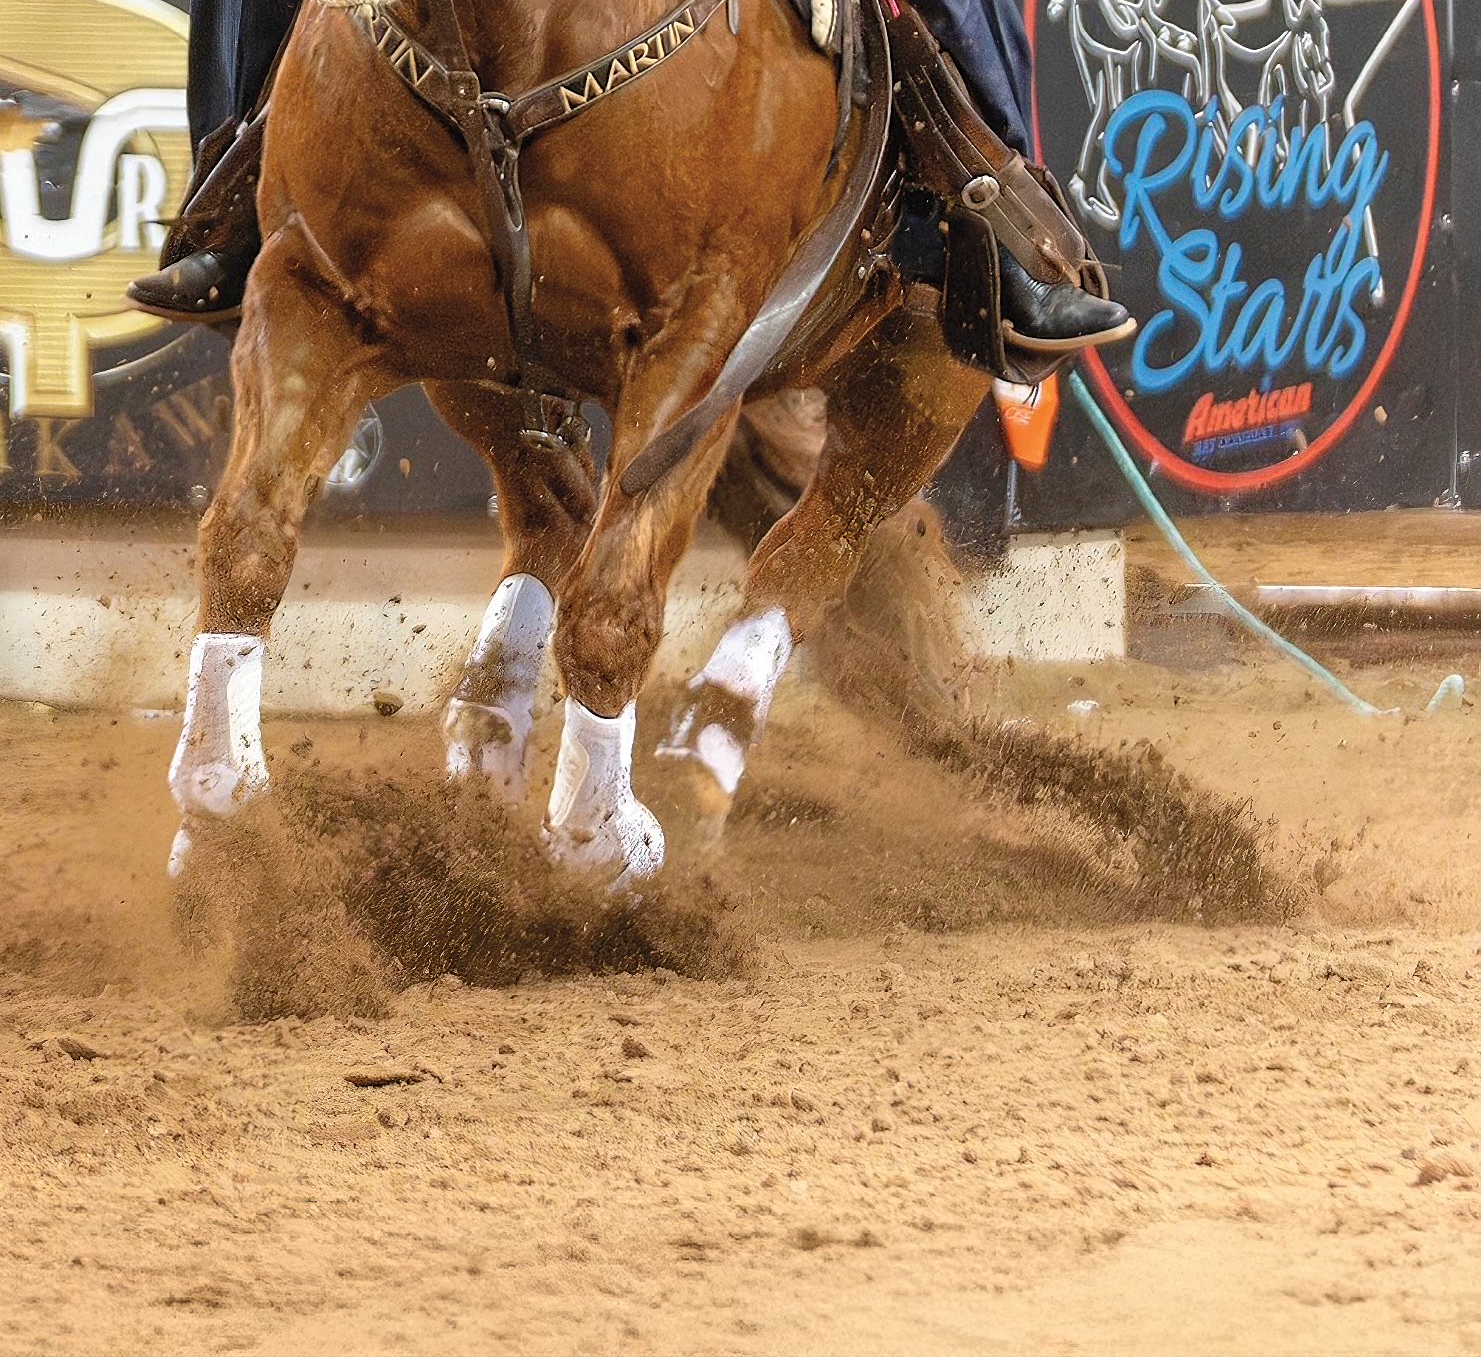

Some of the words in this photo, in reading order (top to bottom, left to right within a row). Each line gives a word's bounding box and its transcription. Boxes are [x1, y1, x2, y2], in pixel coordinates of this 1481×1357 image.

[558, 8, 696, 113] MARTIN
[1104, 89, 1388, 283] Rising
[1131, 229, 1382, 395] Stars
